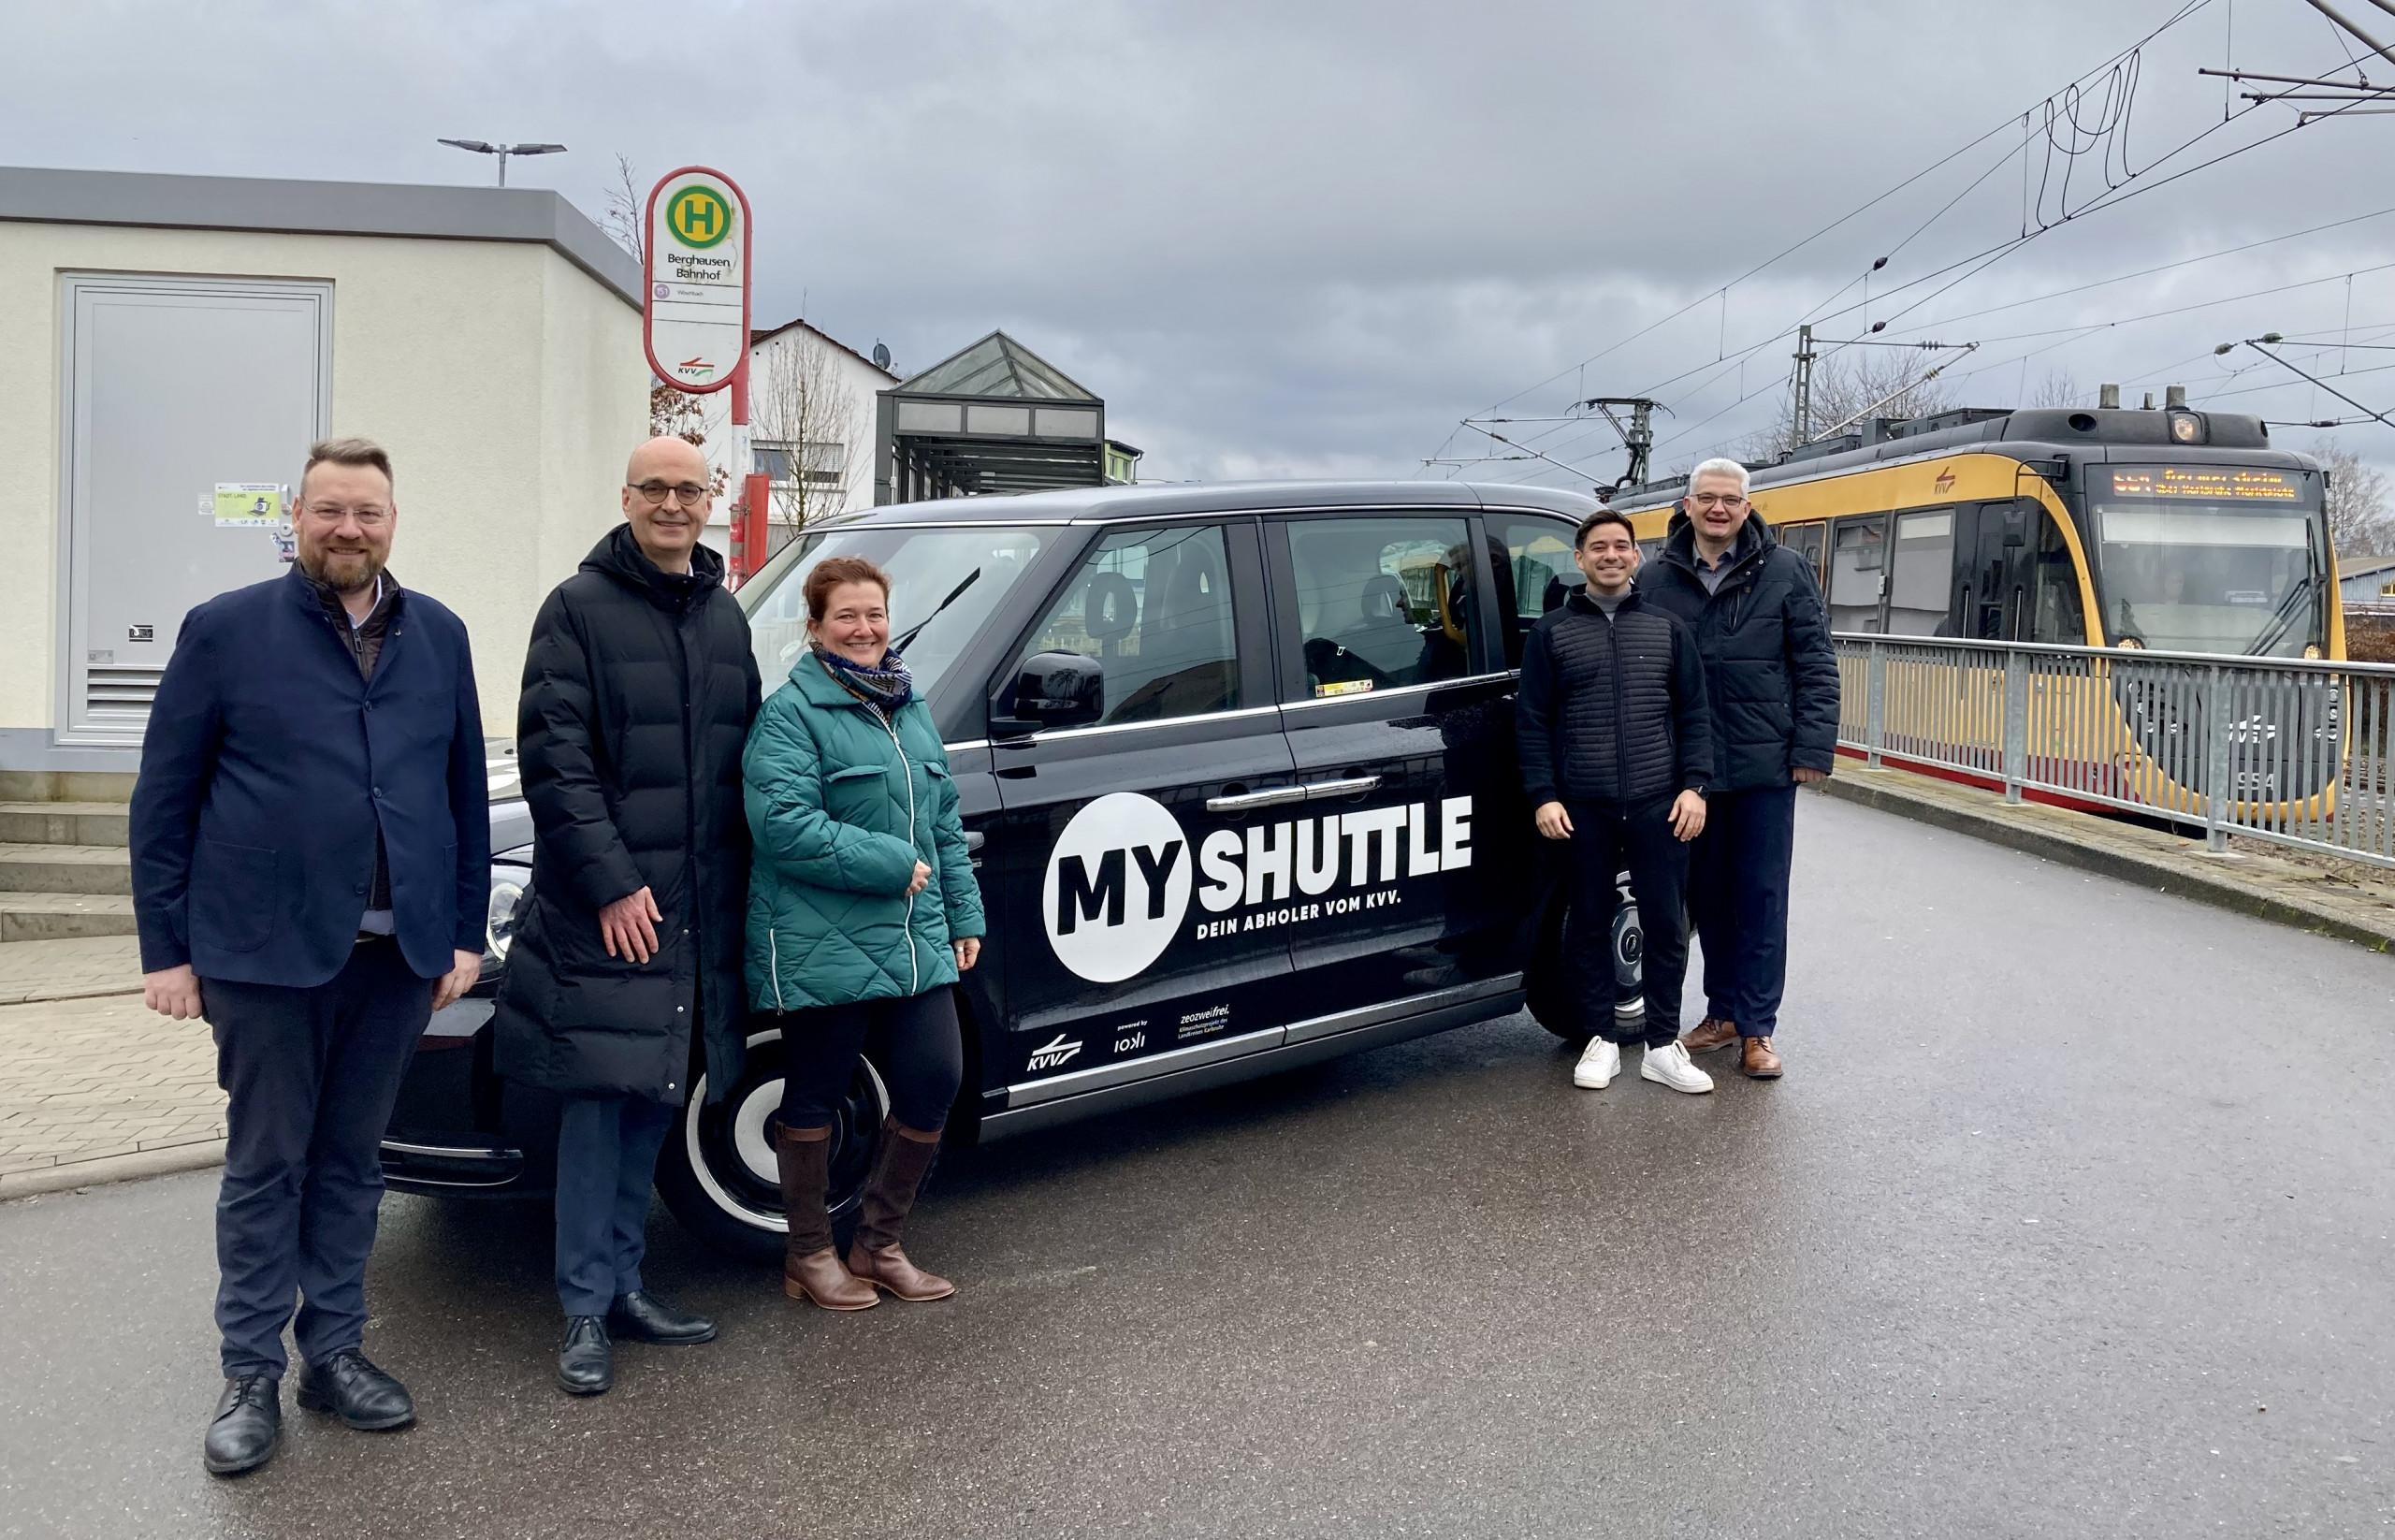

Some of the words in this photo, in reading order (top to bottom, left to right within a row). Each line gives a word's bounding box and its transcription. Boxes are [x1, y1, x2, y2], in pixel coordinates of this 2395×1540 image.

[684, 199, 714, 234] H
[668, 254, 731, 267] Berghausen
[676, 269, 720, 280] Bahnhof
[1056, 839, 1183, 937] MY
[1198, 795, 1473, 912] SHUTTLE
[1197, 918, 1238, 939] DEIN
[1242, 904, 1319, 932] ABHOLER
[1325, 895, 1360, 916] VOM
[1366, 889, 1401, 908] KVV.
[1026, 1052, 1063, 1072] KVV
